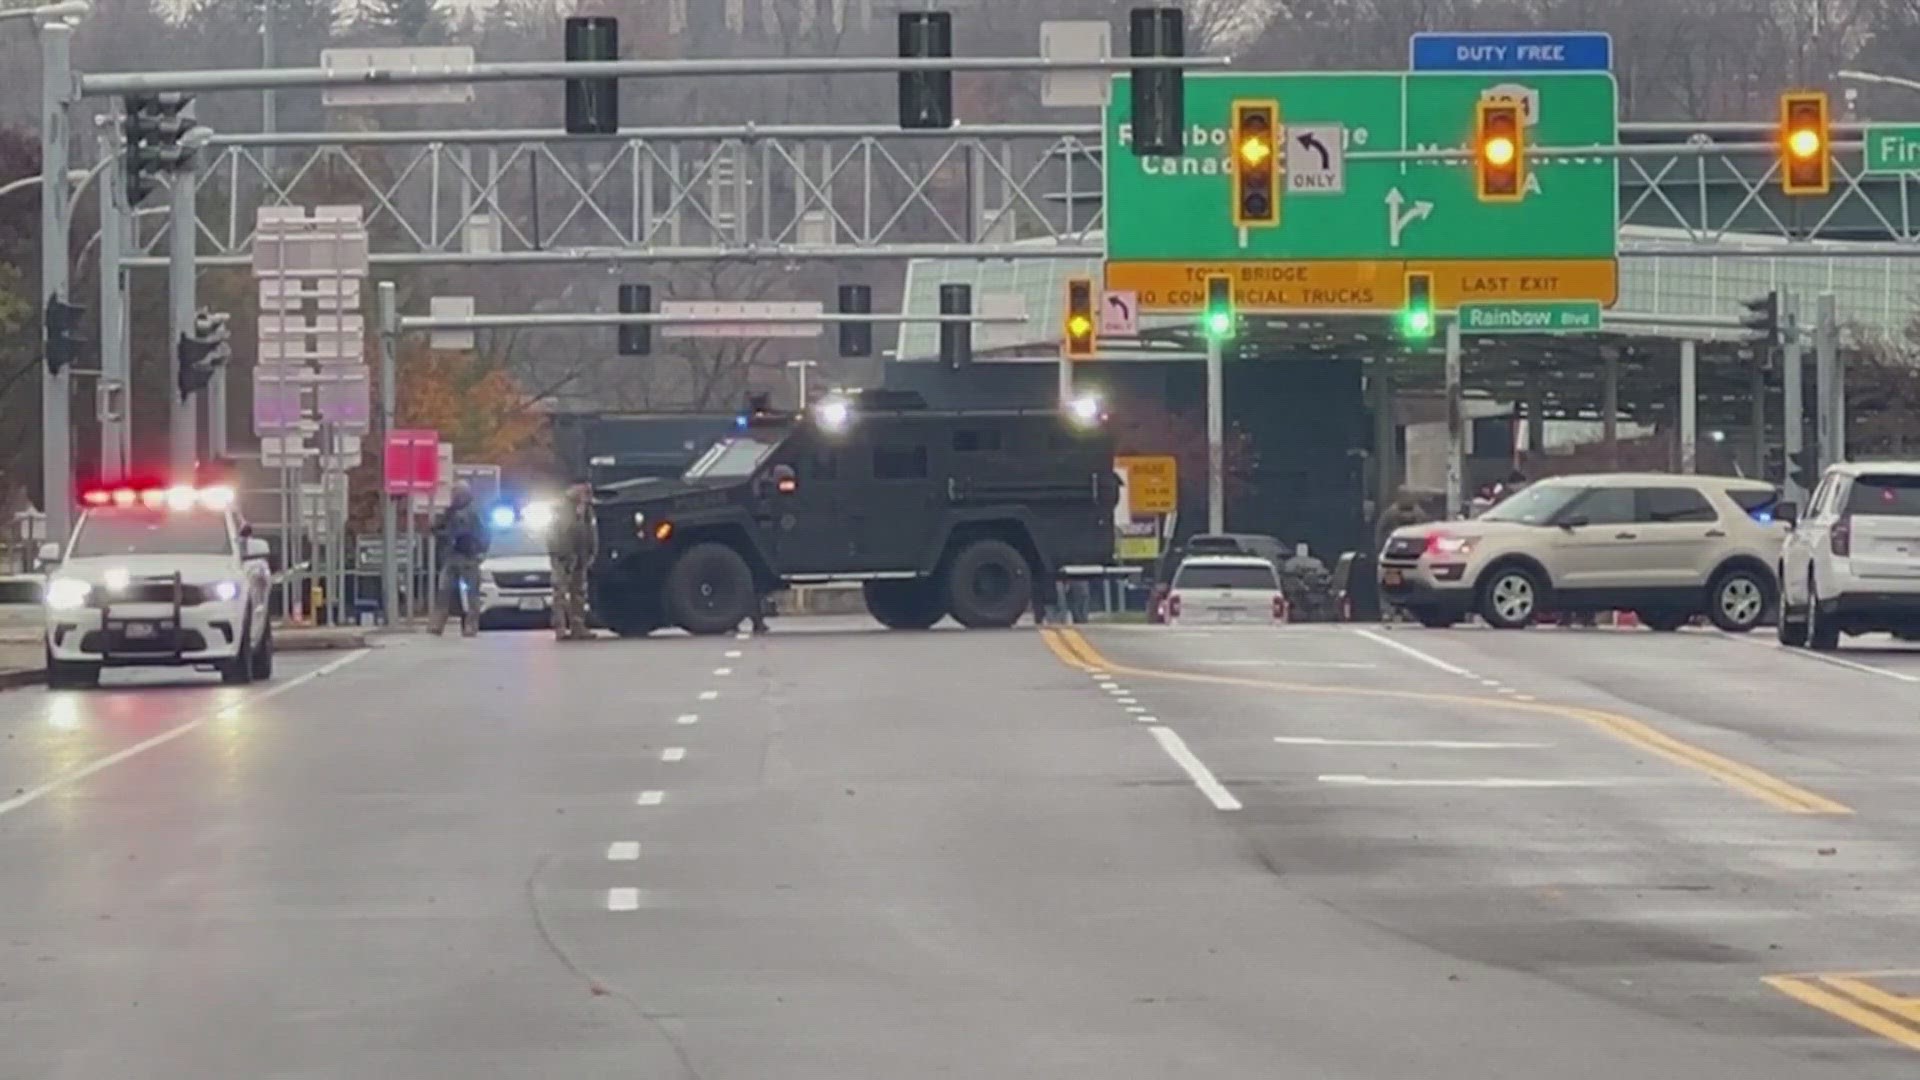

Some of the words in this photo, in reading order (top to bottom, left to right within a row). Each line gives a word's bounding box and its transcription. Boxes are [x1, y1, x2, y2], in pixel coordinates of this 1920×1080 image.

[1456, 45, 1507, 61] DUTY
[1516, 45, 1565, 61] FREE
[1881, 136, 1920, 162] Fir
[1141, 153, 1233, 175] Canad
[1293, 173, 1336, 188] ONLY
[1241, 266, 1309, 282] BRIDGE
[1461, 276, 1510, 292] LAST
[1519, 276, 1560, 292] EXIT
[1167, 288, 1288, 304] COMRCIAL
[1302, 287, 1375, 304] TRUCKS
[1469, 308, 1552, 327] Rainbow
